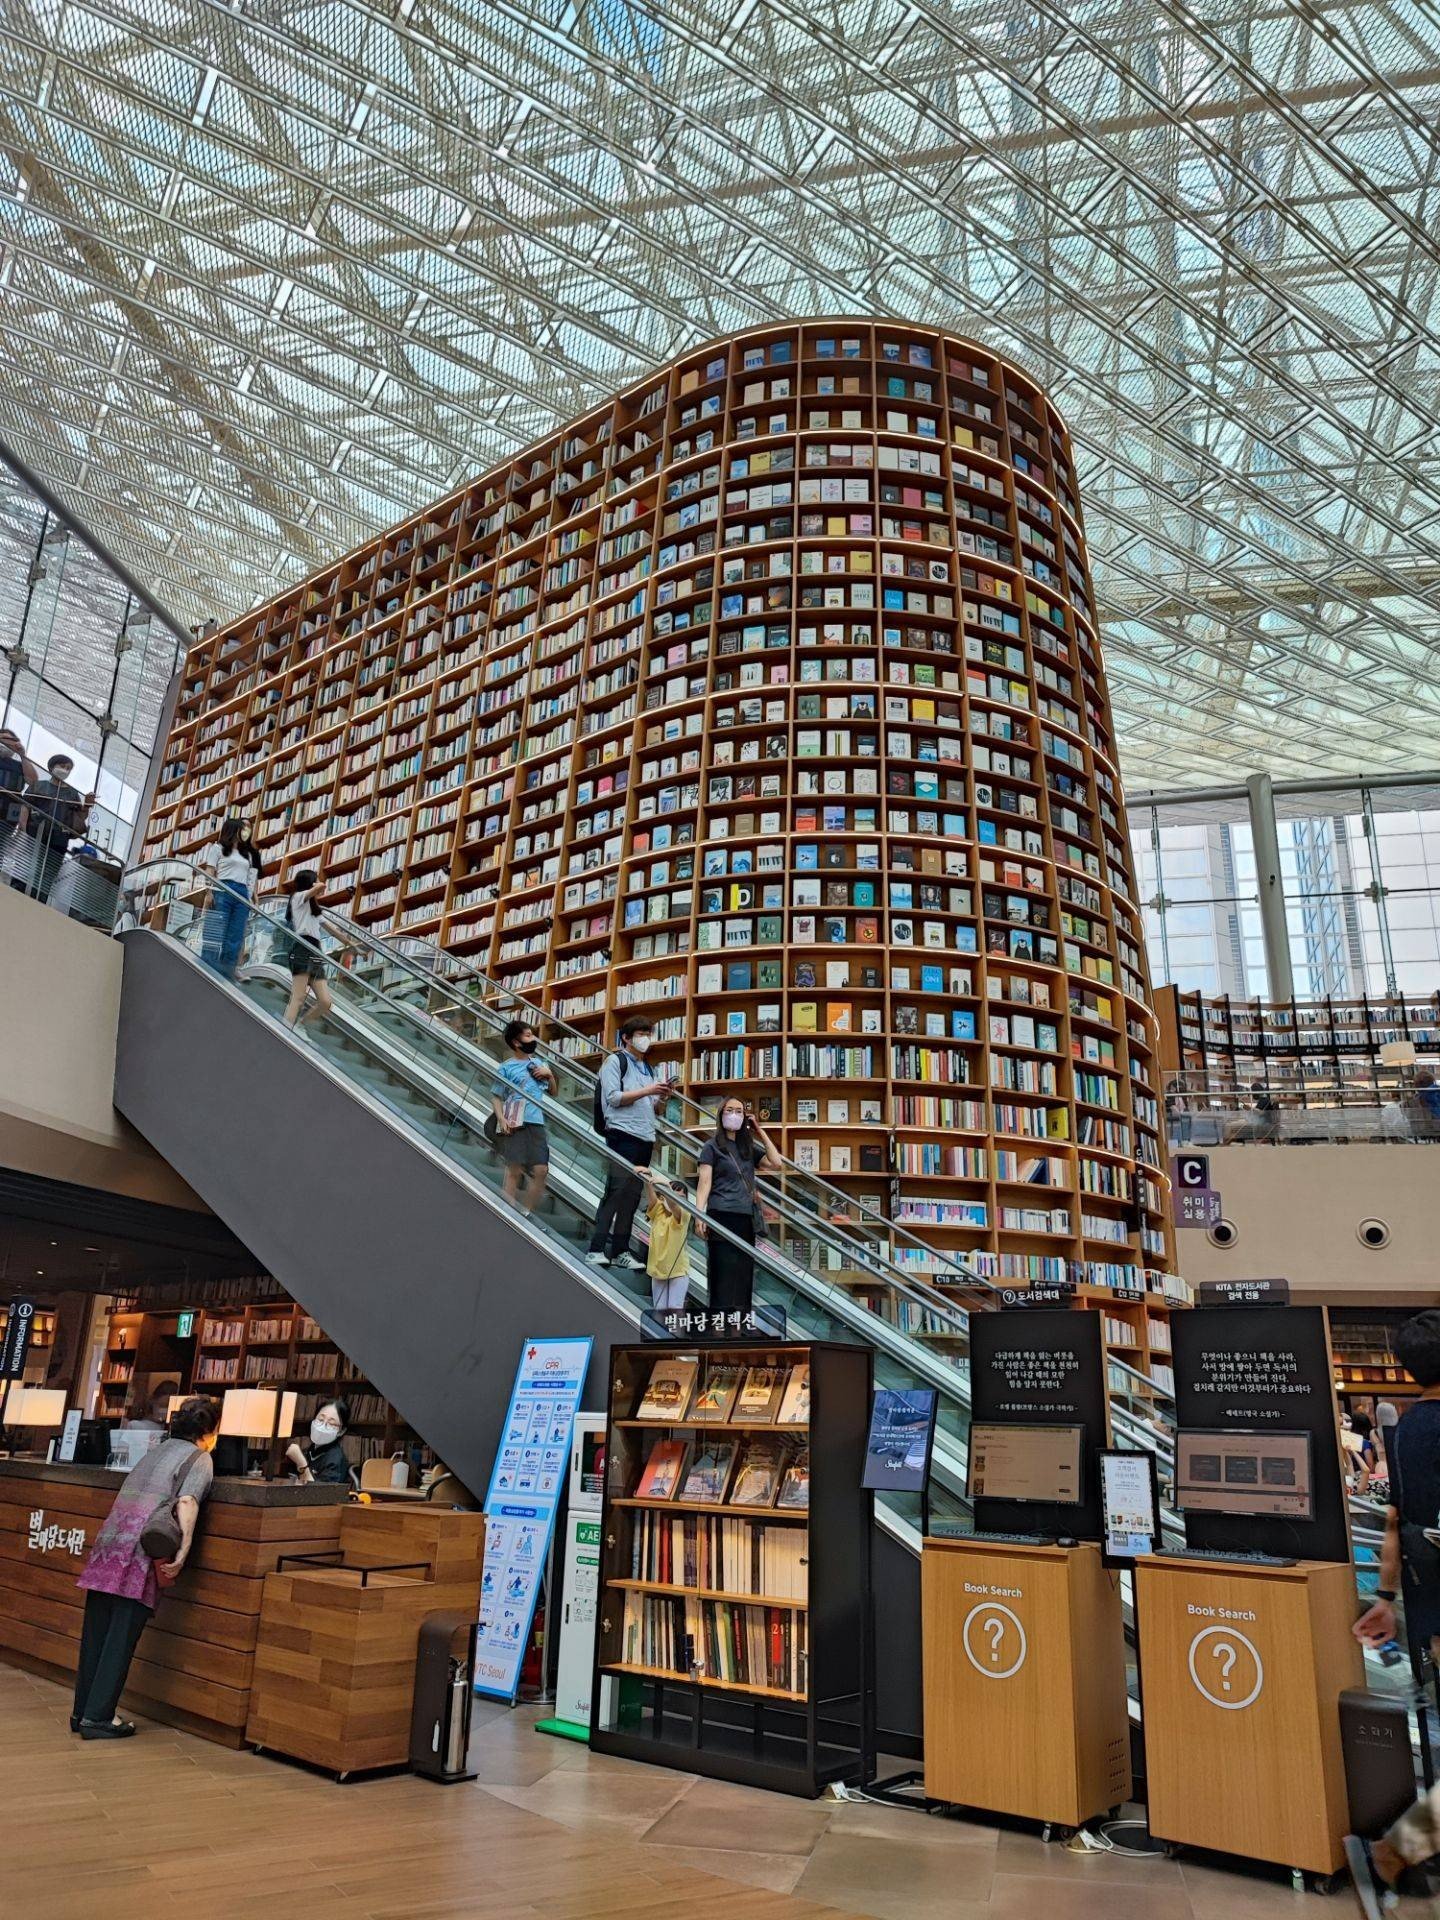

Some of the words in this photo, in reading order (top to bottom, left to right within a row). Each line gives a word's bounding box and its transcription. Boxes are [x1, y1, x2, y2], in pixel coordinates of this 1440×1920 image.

[1183, 1161, 1202, 1185] C
[1183, 1196, 1204, 1208] 취미
[1183, 1208, 1206, 1220] 실용
[1215, 1283, 1233, 1291] KITA
[1235, 1281, 1270, 1291] 전자도서관
[1017, 1290, 1060, 1301] 도서검색대
[1227, 1291, 1243, 1301] 검색
[1244, 1290, 1260, 1300] 전용
[664, 1313, 708, 1333] 별마당
[711, 1311, 757, 1332] 컬렉션
[10, 1319, 28, 1372] INFORMATION
[1201, 1352, 1231, 1361] 무엇이나
[1233, 1352, 1257, 1361] 좋으니
[1259, 1352, 1275, 1361] 책을
[545, 1361, 560, 1370] CPR
[1219, 1362, 1235, 1372] 방에
[1273, 1363, 1297, 1372] 독서의
[1211, 1373, 1242, 1382] 분위기가
[1244, 1373, 1268, 1383] 만들어
[1240, 1384, 1278, 1393] 이것부터가
[1279, 1384, 1311, 1394] 중요하다
[587, 1532, 600, 1543] AE
[963, 1582, 989, 1595] Book
[990, 1585, 1023, 1598] Search
[1187, 1604, 1216, 1618] Book
[1218, 1607, 1257, 1622] Search
[487, 1664, 507, 1680] Seoul
